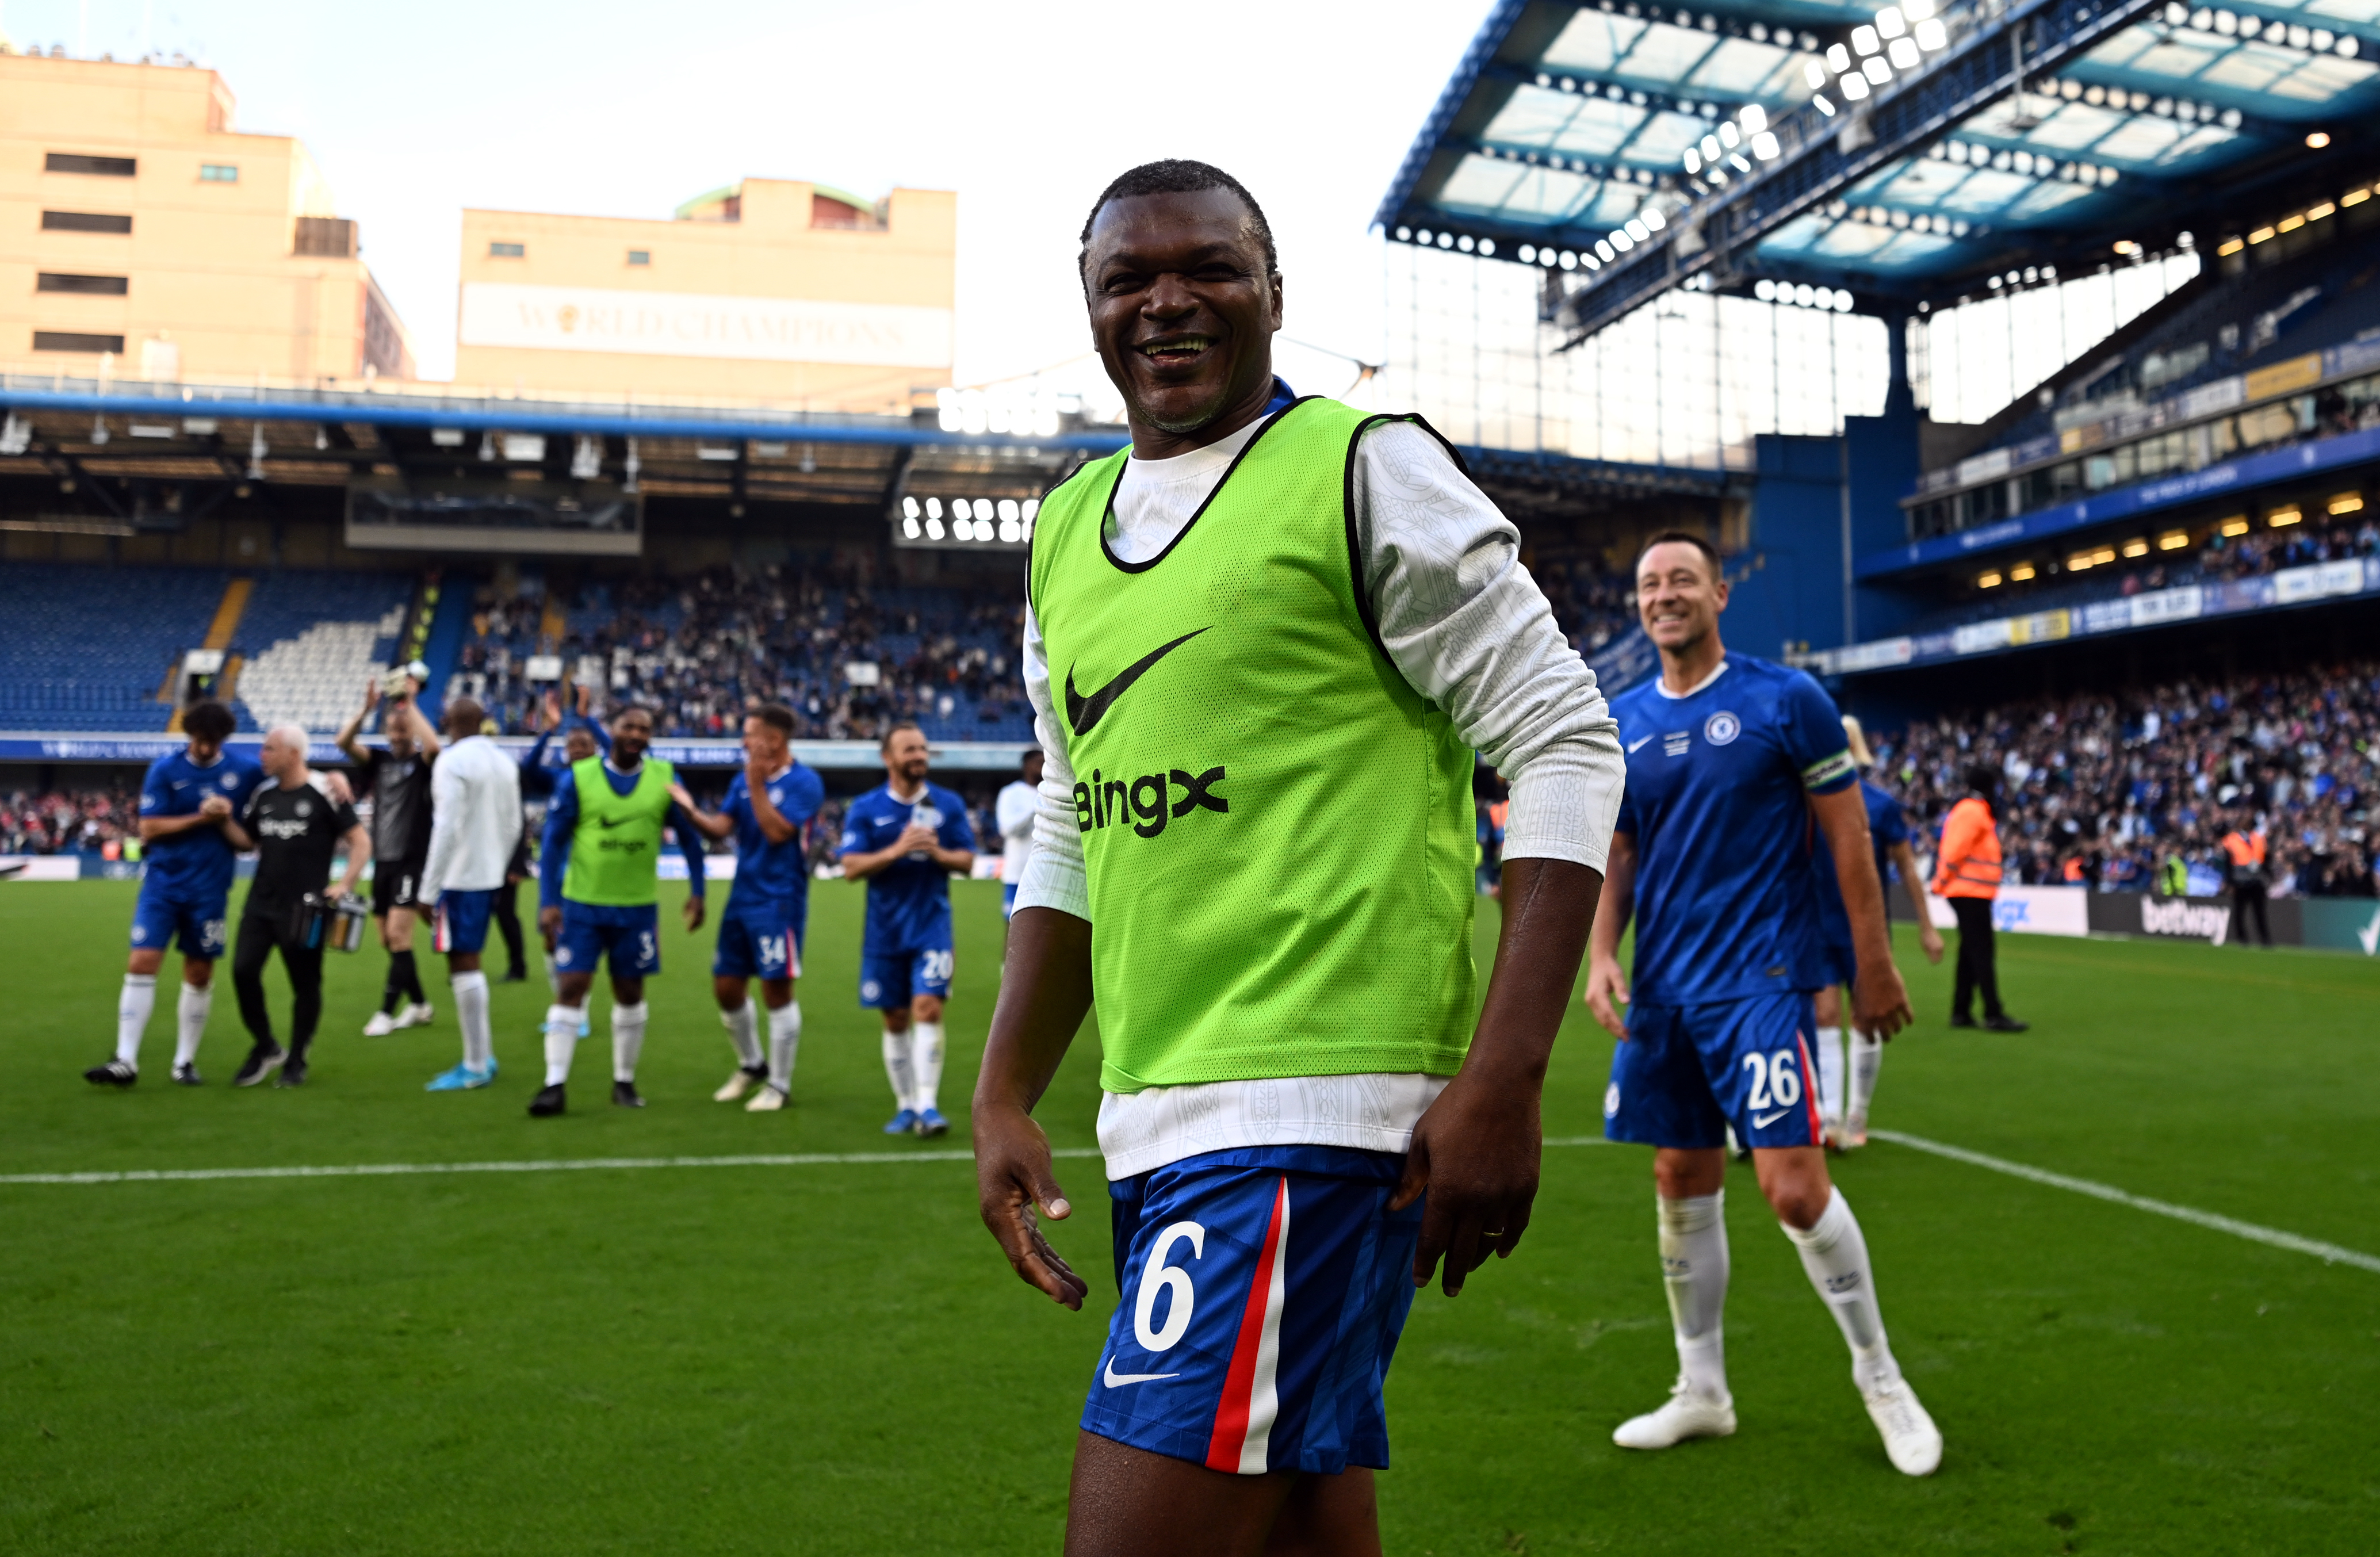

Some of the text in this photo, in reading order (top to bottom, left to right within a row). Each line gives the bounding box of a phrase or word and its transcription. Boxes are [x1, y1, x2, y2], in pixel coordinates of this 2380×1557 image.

[2141, 894, 2231, 946] betway
[758, 935, 786, 966] 34
[921, 949, 954, 980] 20
[1743, 1049, 1801, 1111] 26
[1134, 1221, 1206, 1352] 6
